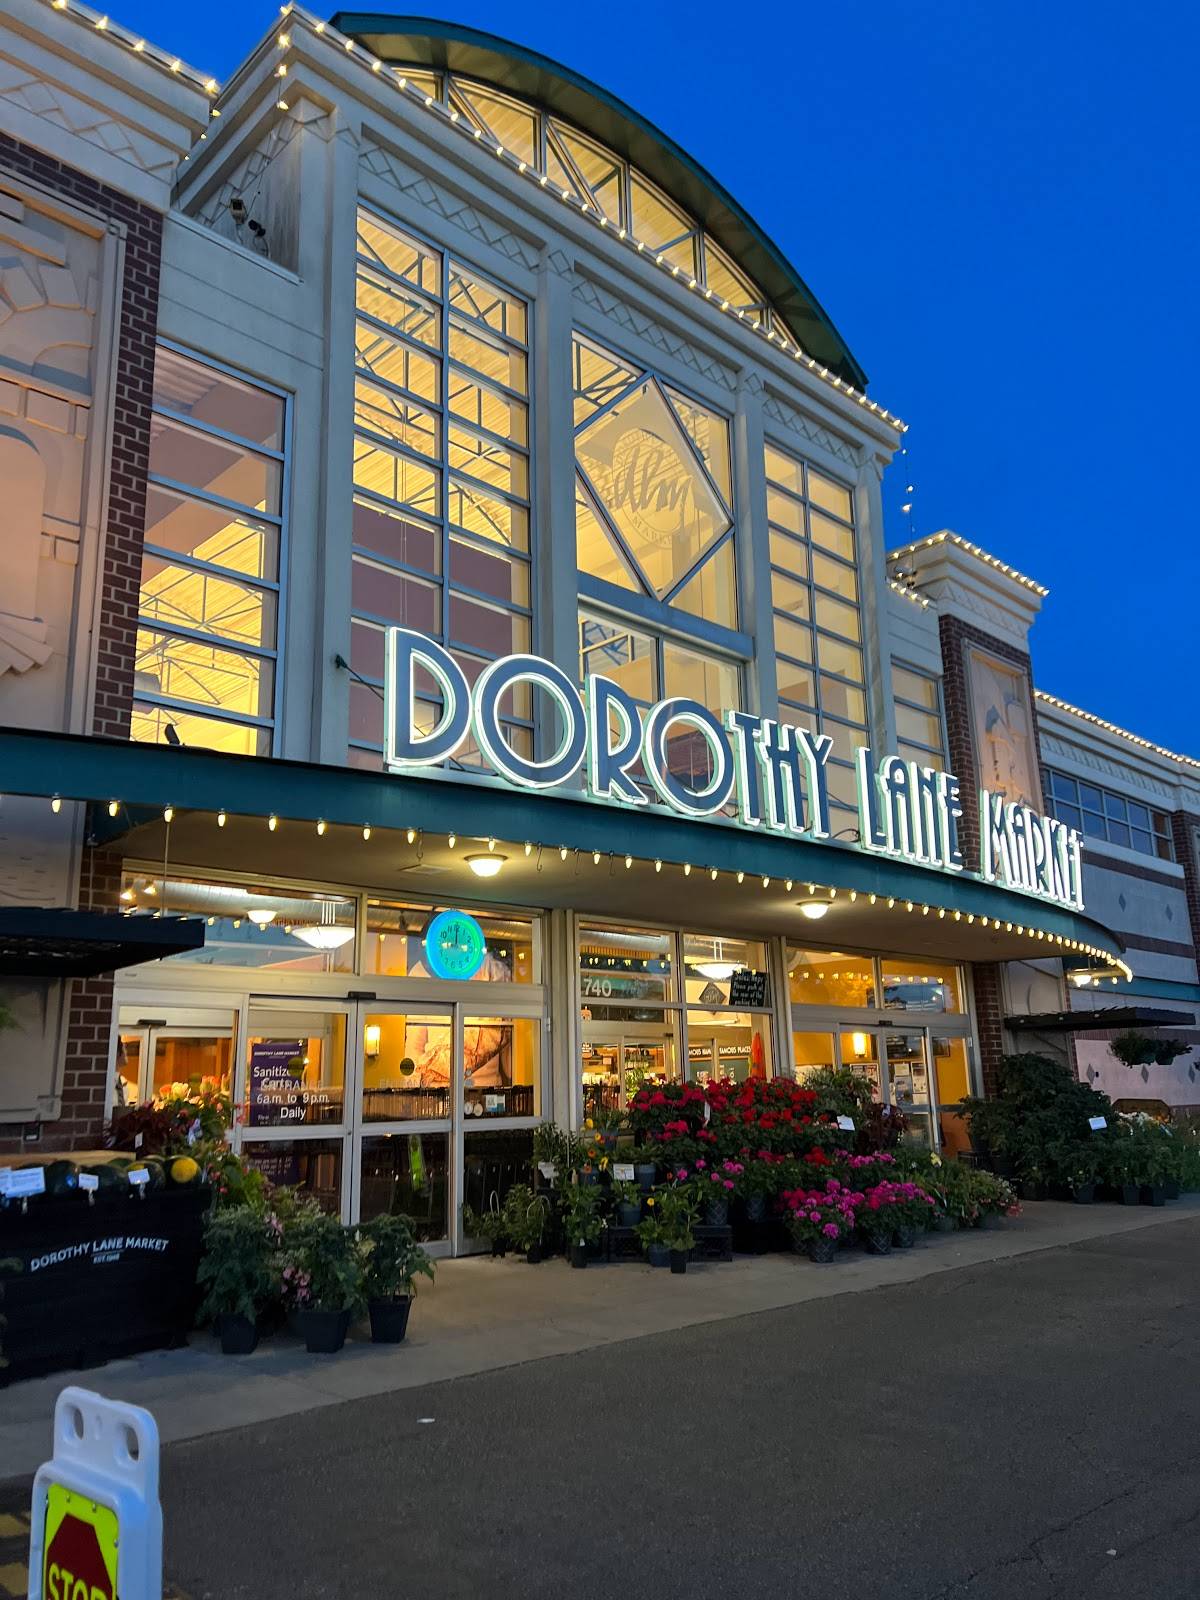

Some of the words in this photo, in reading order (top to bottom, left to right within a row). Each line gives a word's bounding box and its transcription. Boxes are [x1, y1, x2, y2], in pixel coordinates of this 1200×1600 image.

[384, 626, 833, 839] DOROTHY
[855, 746, 964, 872] LANE
[979, 788, 1086, 912] MARKET
[583, 978, 612, 997] 740
[719, 1046, 736, 1055] FAMOUS
[737, 1045, 752, 1053] PLACES
[253, 1066, 291, 1078] Sanitiz
[287, 1093, 297, 1104] to
[280, 1106, 307, 1120] Daily
[30, 1242, 91, 1272] DOROTHY
[92, 1237, 124, 1252] LANE
[125, 1237, 169, 1252] MARKET
